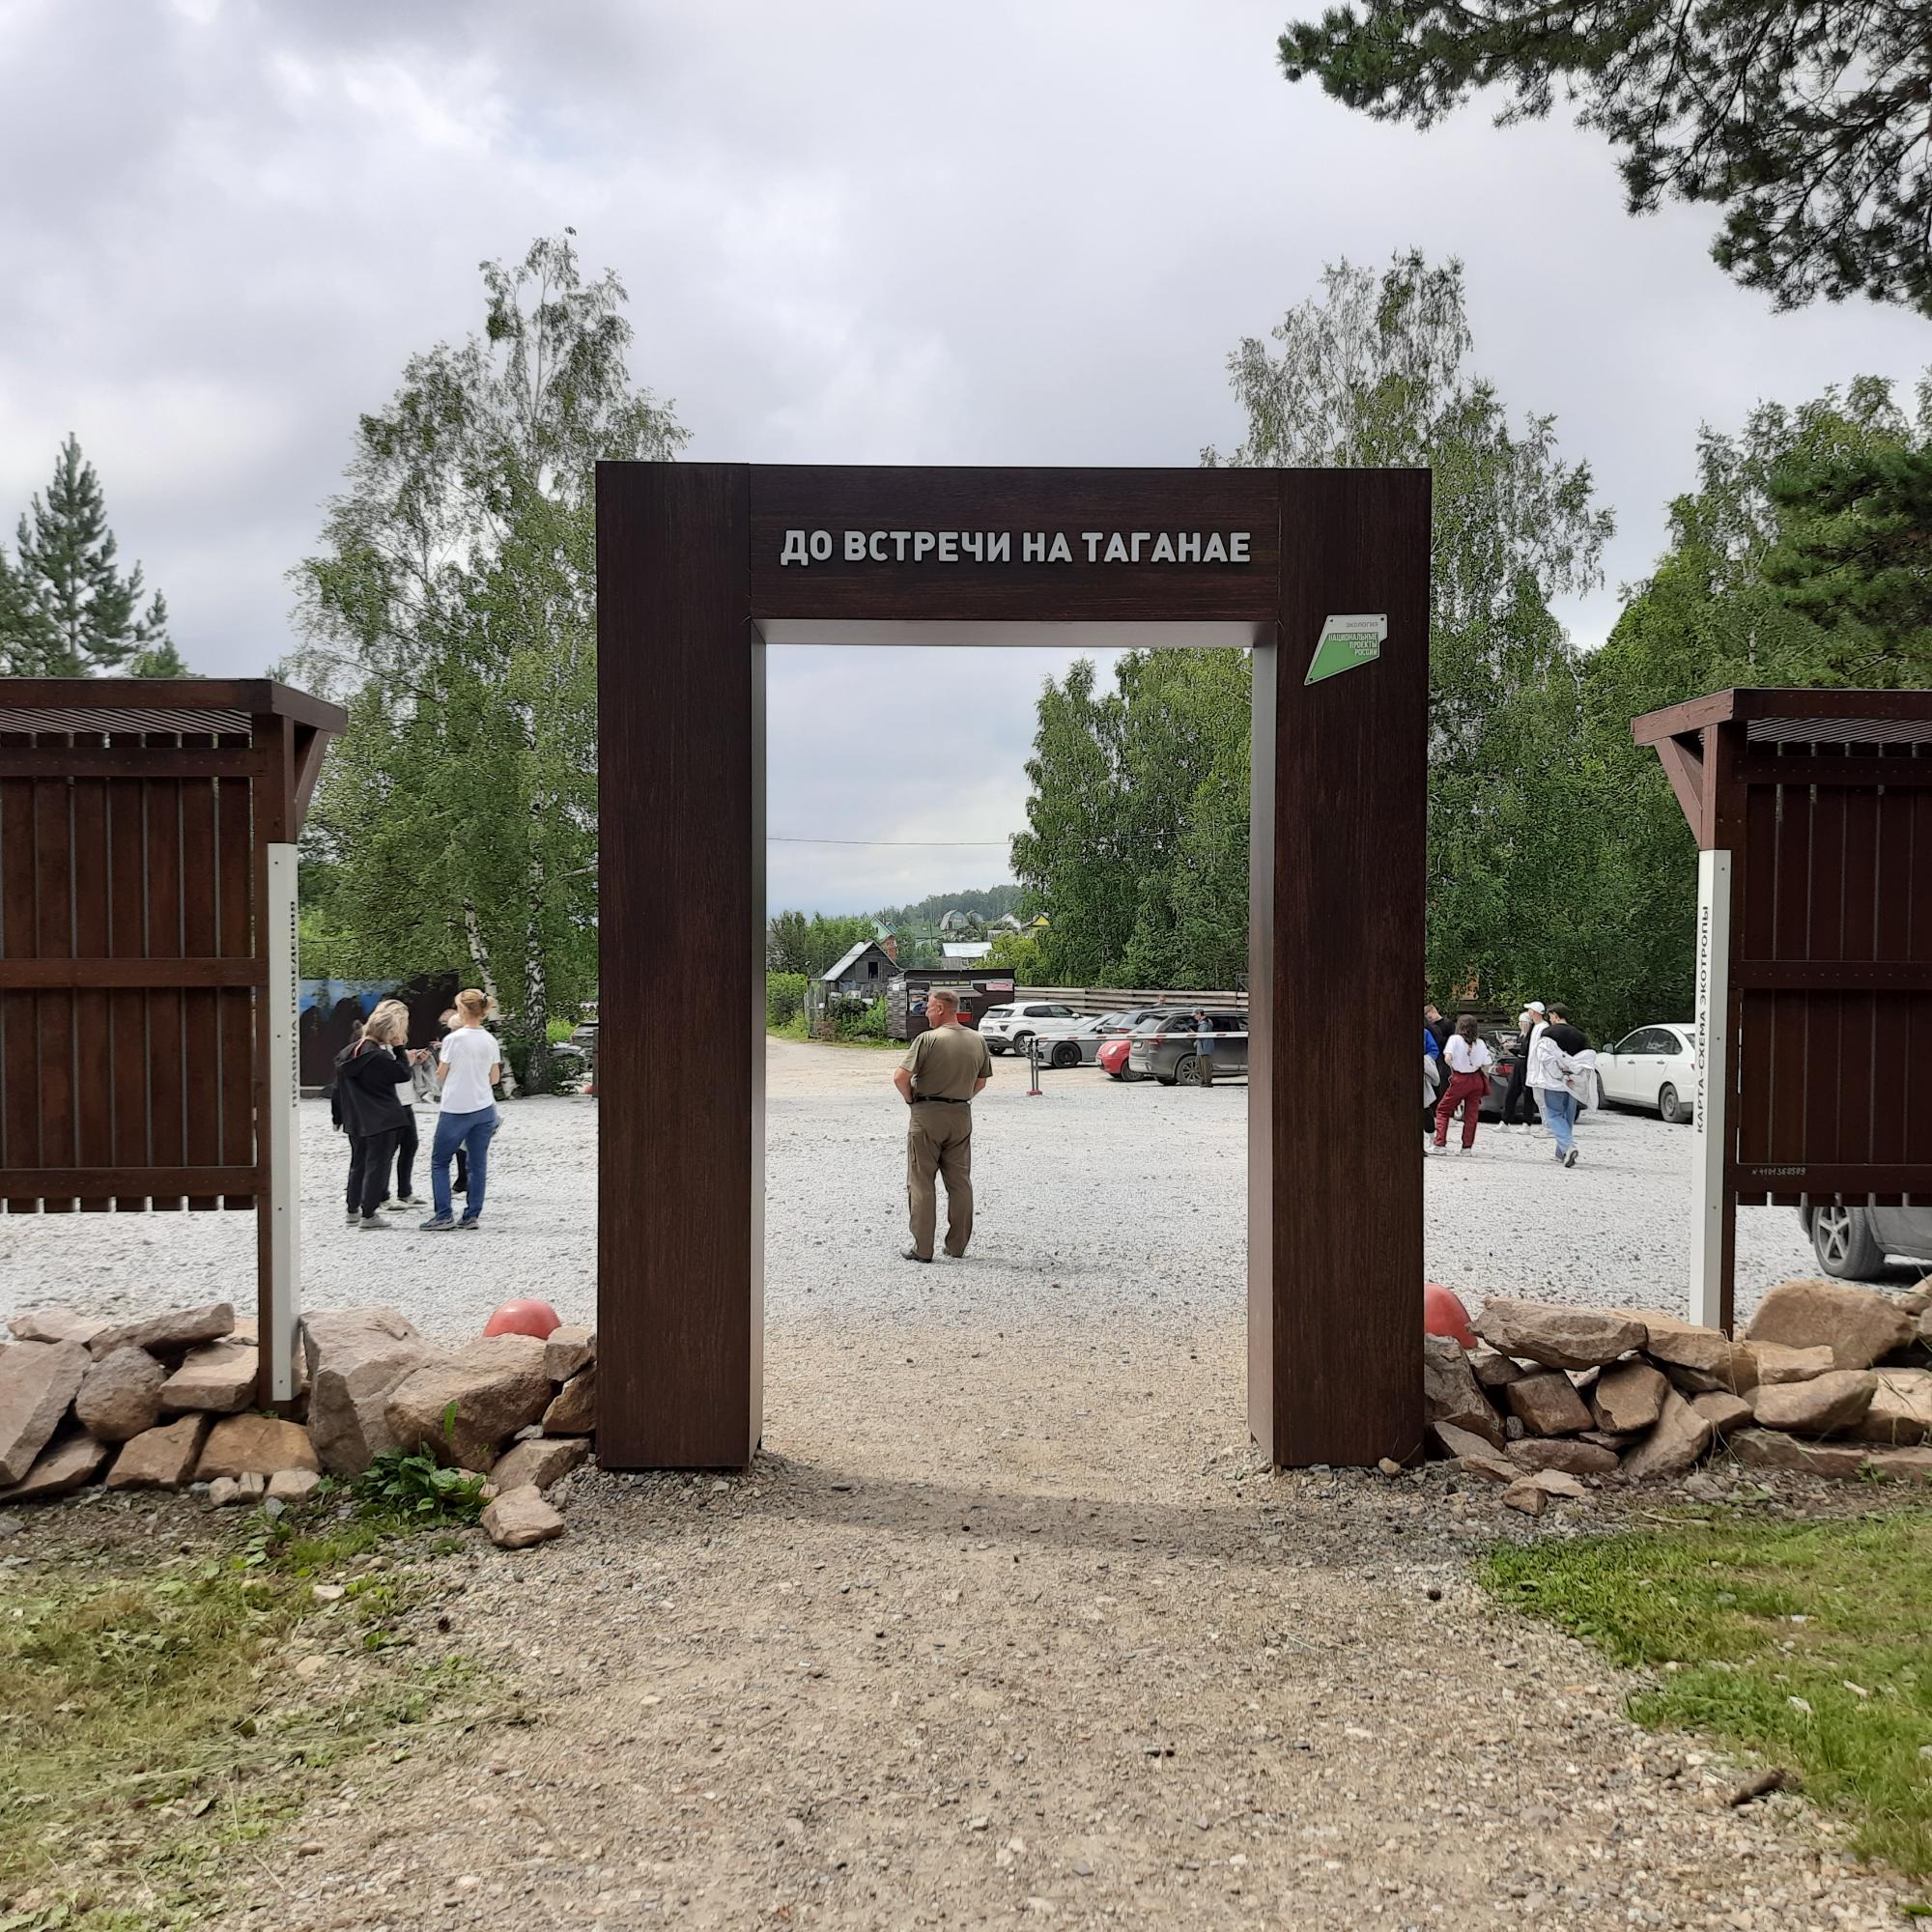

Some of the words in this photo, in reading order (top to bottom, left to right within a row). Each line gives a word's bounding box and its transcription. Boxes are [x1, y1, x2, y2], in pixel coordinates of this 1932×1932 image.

[781, 529, 833, 566] ДО
[844, 530, 1010, 562] ВСТРЕЧИ
[1023, 532, 1073, 562] НА
[1081, 532, 1251, 562] ТАГАНАЕ
[1328, 633, 1378, 641] НАЦИОНАЛЬНЫЕ
[1700, 905, 1709, 1005] ЭКОТРОПЫ
[1697, 1009, 1707, 1133] КАРТА-СХЕМА
